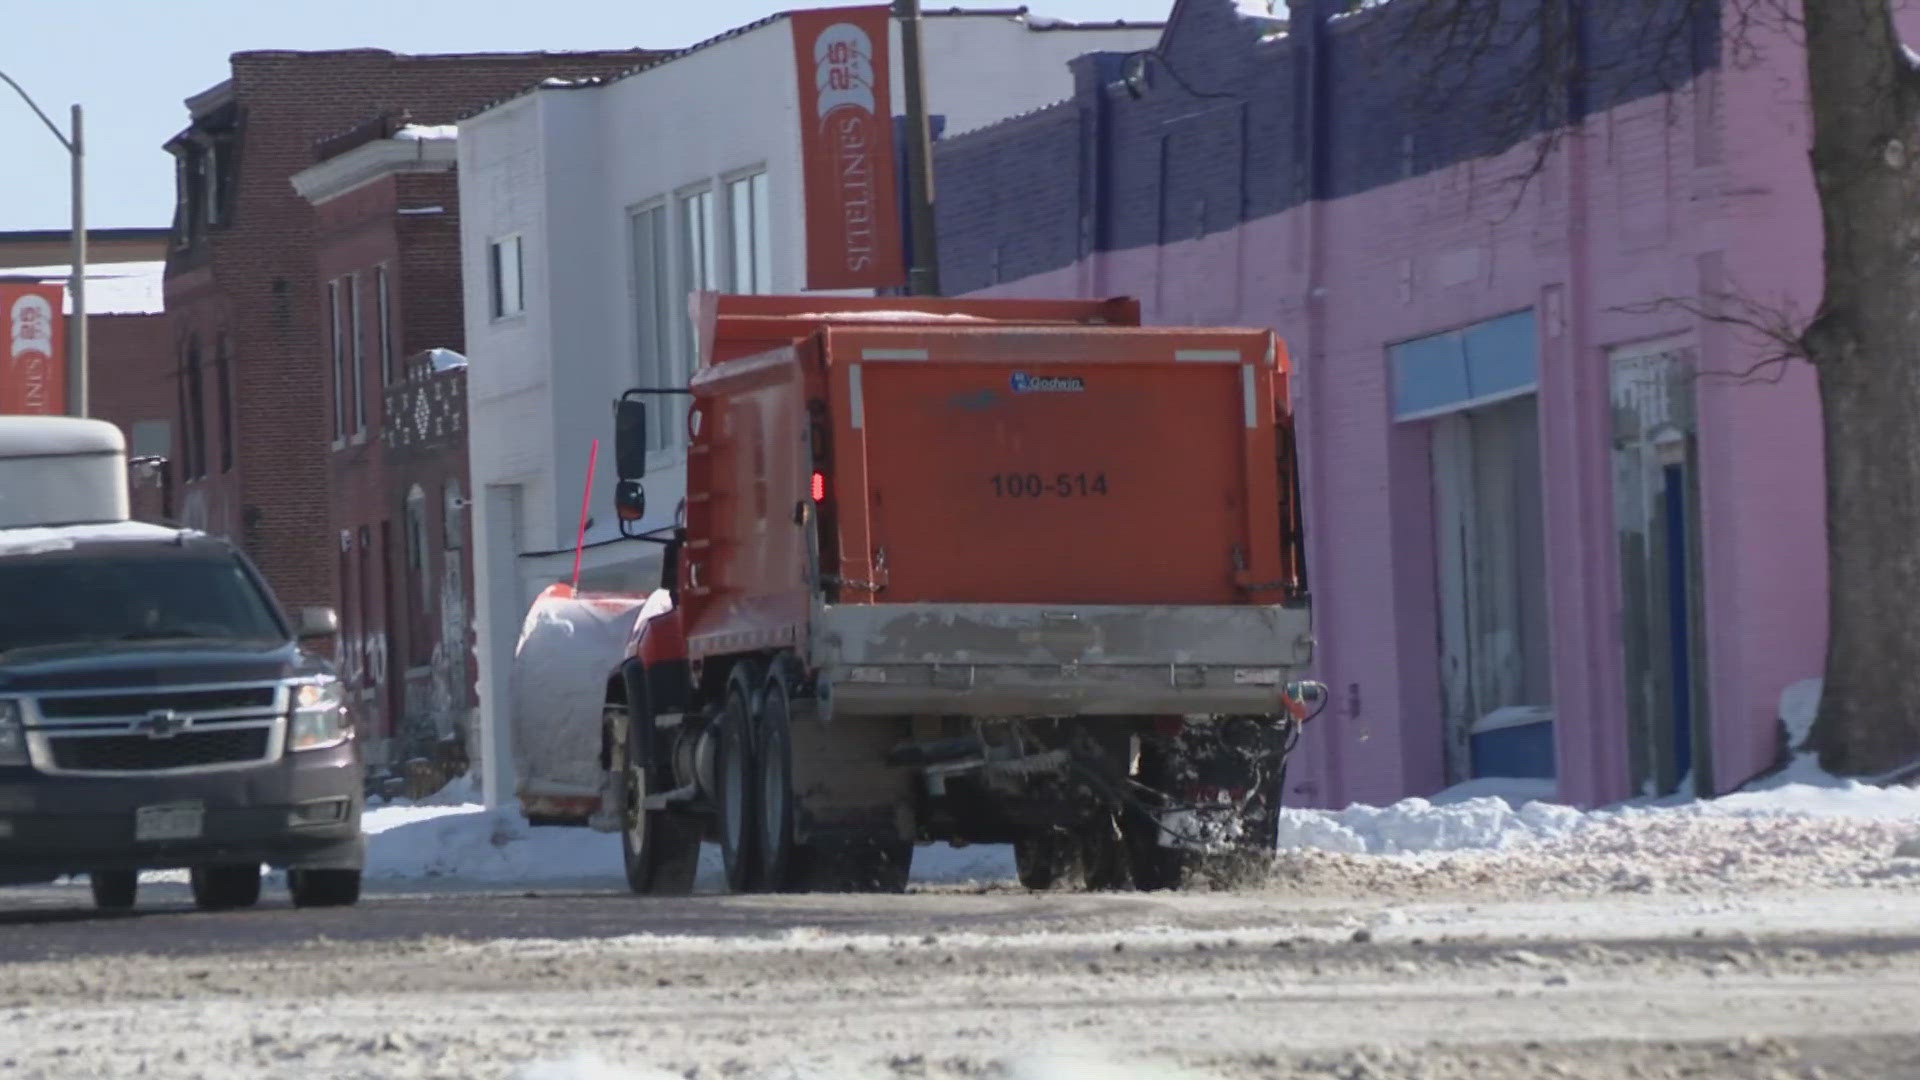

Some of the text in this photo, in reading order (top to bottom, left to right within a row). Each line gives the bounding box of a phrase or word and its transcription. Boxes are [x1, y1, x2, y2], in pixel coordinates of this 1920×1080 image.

[827, 42, 849, 90] 25
[1029, 376, 1080, 389] Godwin
[991, 473, 1108, 497] 100-514
